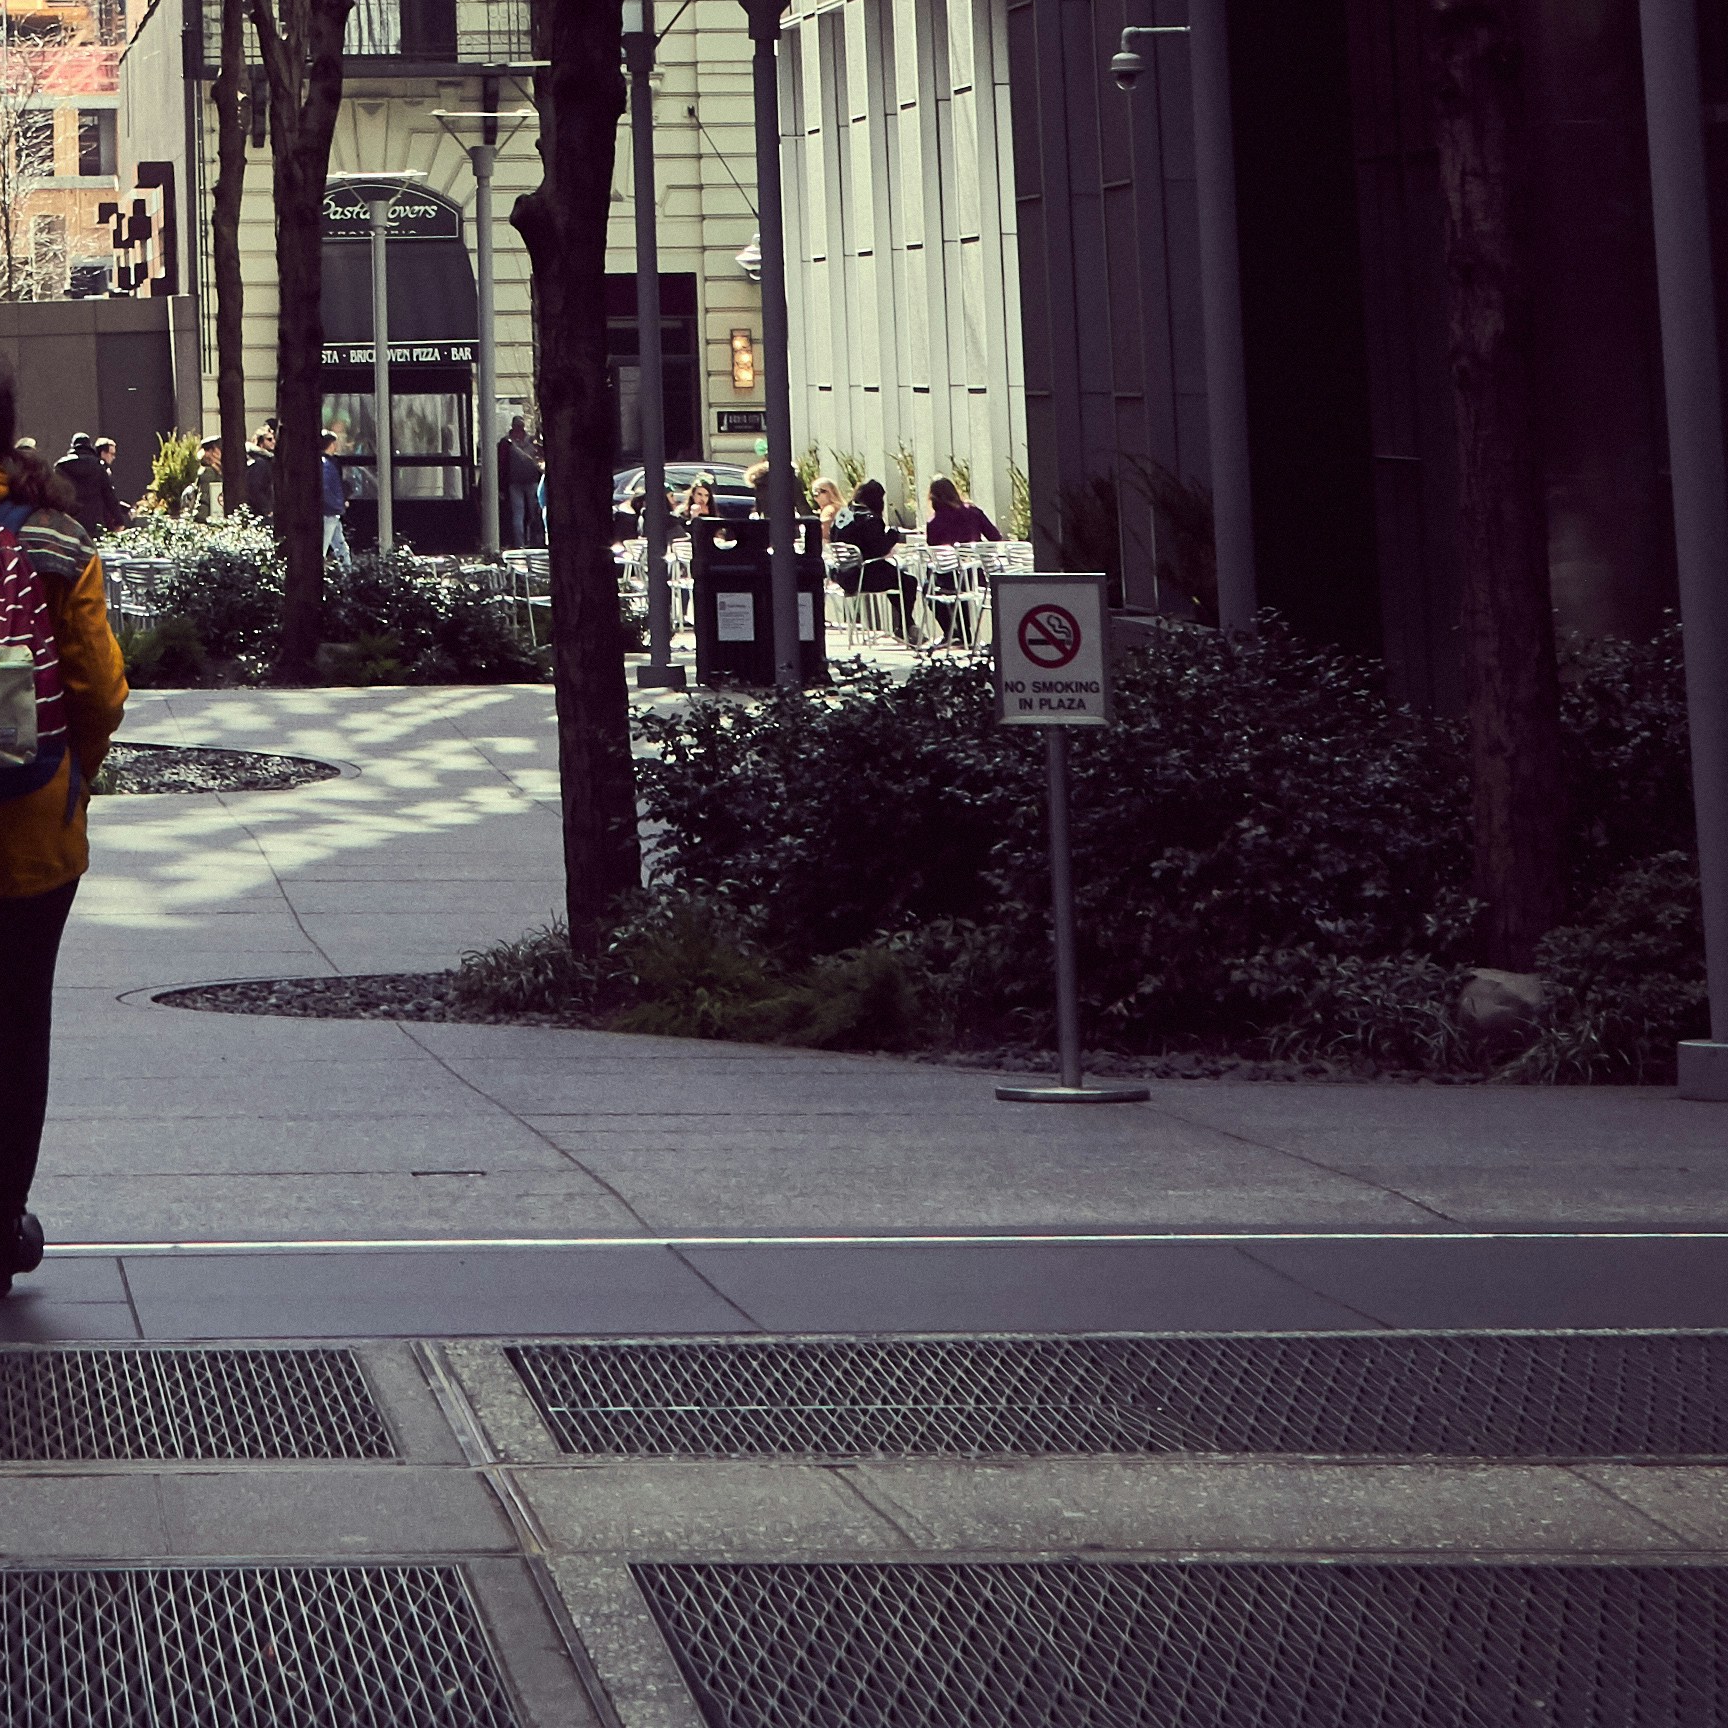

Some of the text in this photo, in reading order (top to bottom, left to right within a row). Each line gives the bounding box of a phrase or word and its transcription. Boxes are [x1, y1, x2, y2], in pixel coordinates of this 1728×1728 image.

[323, 194, 370, 220] Pasta
[349, 349, 377, 363] BRIC
[413, 348, 440, 361] PIZZA
[451, 347, 472, 360] BAR
[1004, 681, 1100, 693] NO SMOKING
[1019, 698, 1086, 710] IN PLAZA
